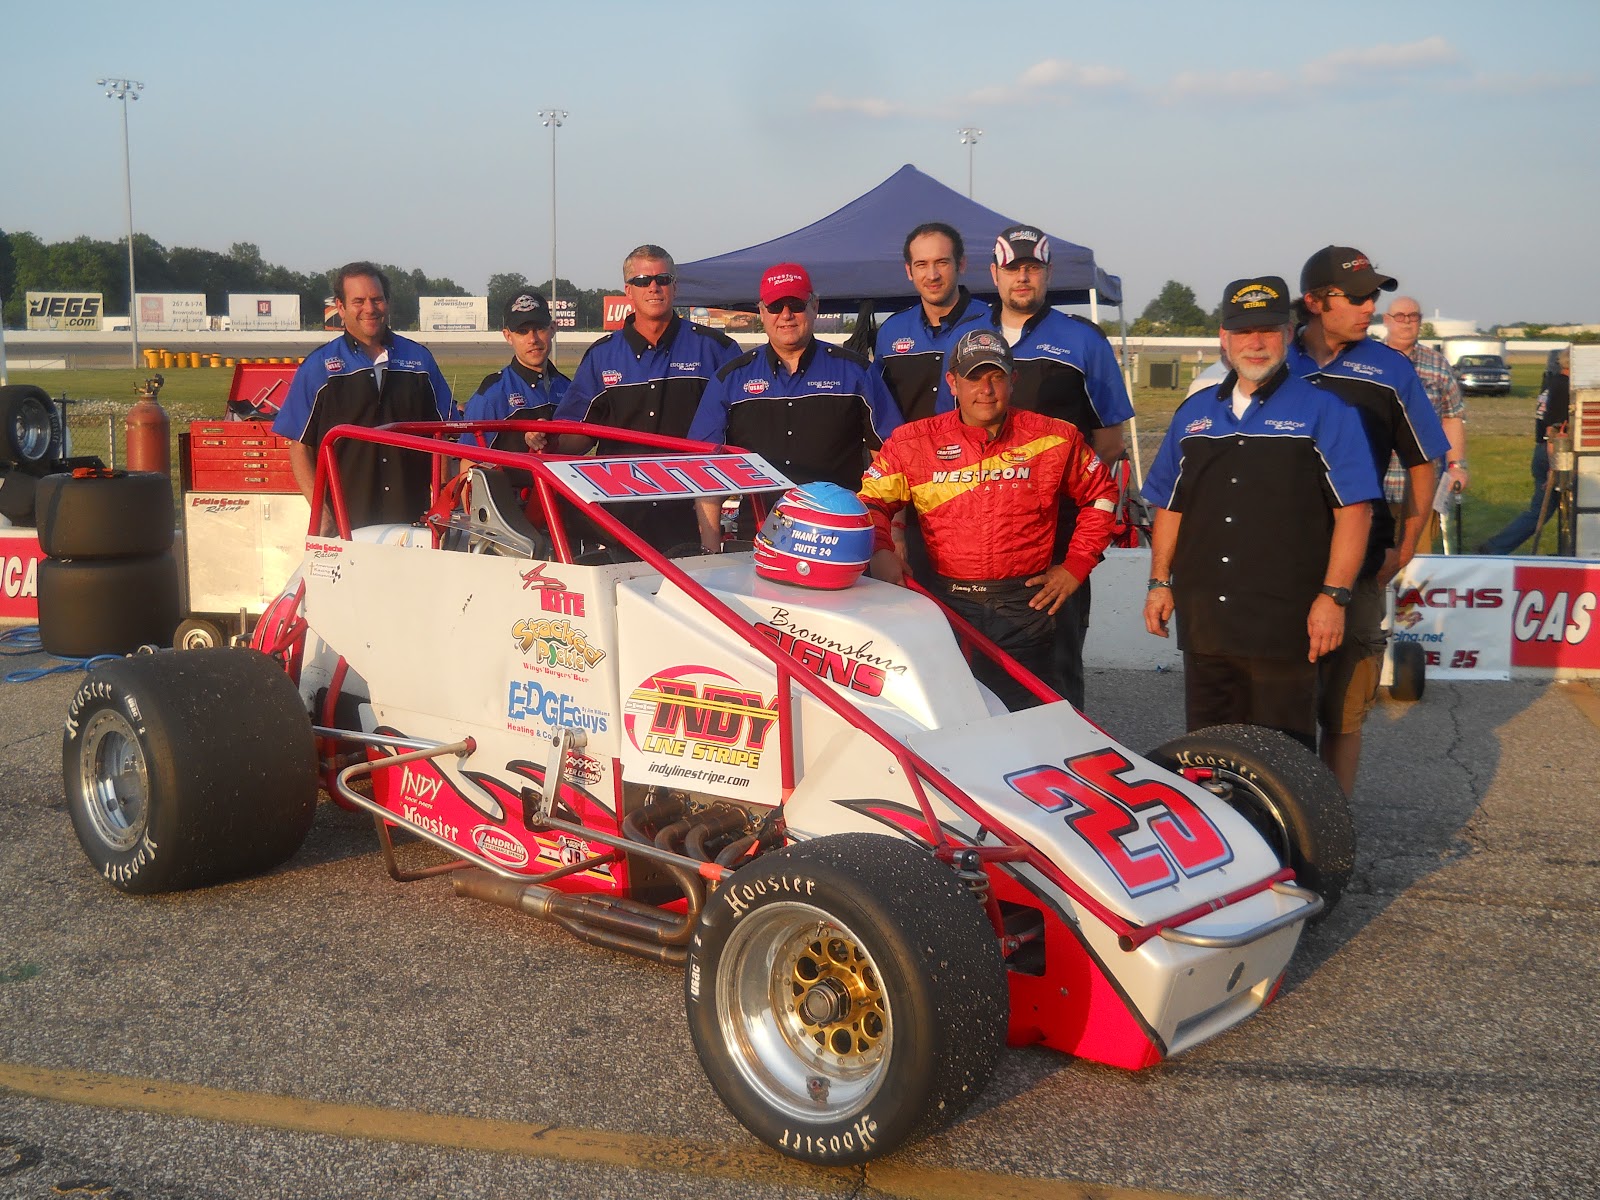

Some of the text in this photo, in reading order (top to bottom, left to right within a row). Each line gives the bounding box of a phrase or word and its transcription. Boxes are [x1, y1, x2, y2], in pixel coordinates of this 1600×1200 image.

[30, 297, 101, 317] JEGS
[606, 304, 635, 321] LUC
[65, 318, 95, 326] .com
[570, 456, 781, 498] KITE
[932, 467, 1030, 484] WESTCON
[791, 530, 840, 546] THANK YOU
[794, 543, 832, 557] SUITE 24
[314, 551, 338, 559] Racing
[0, 556, 38, 597] CA
[540, 588, 585, 618] KITE
[1395, 588, 1503, 608] ACHS
[1512, 589, 1597, 644] CAS
[511, 618, 606, 669] Stacked
[1450, 650, 1480, 669] 25
[65, 681, 113, 740] Hoosier
[650, 676, 780, 752] INDY
[507, 722, 535, 737] Heating
[536, 729, 541, 738] &
[566, 755, 601, 772] AXXAS
[643, 735, 761, 769] LINE STRIPE
[1176, 751, 1258, 780] Hoosier
[400, 766, 444, 801] INDY
[648, 761, 750, 788] indylinestripe.com
[403, 804, 459, 841] Hoosier
[1003, 747, 1234, 899] 25
[104, 827, 159, 887] Hoosier
[478, 832, 526, 855] LANDRUM
[723, 876, 816, 917] Hoosier
[778, 1114, 879, 1154] Hoosier
